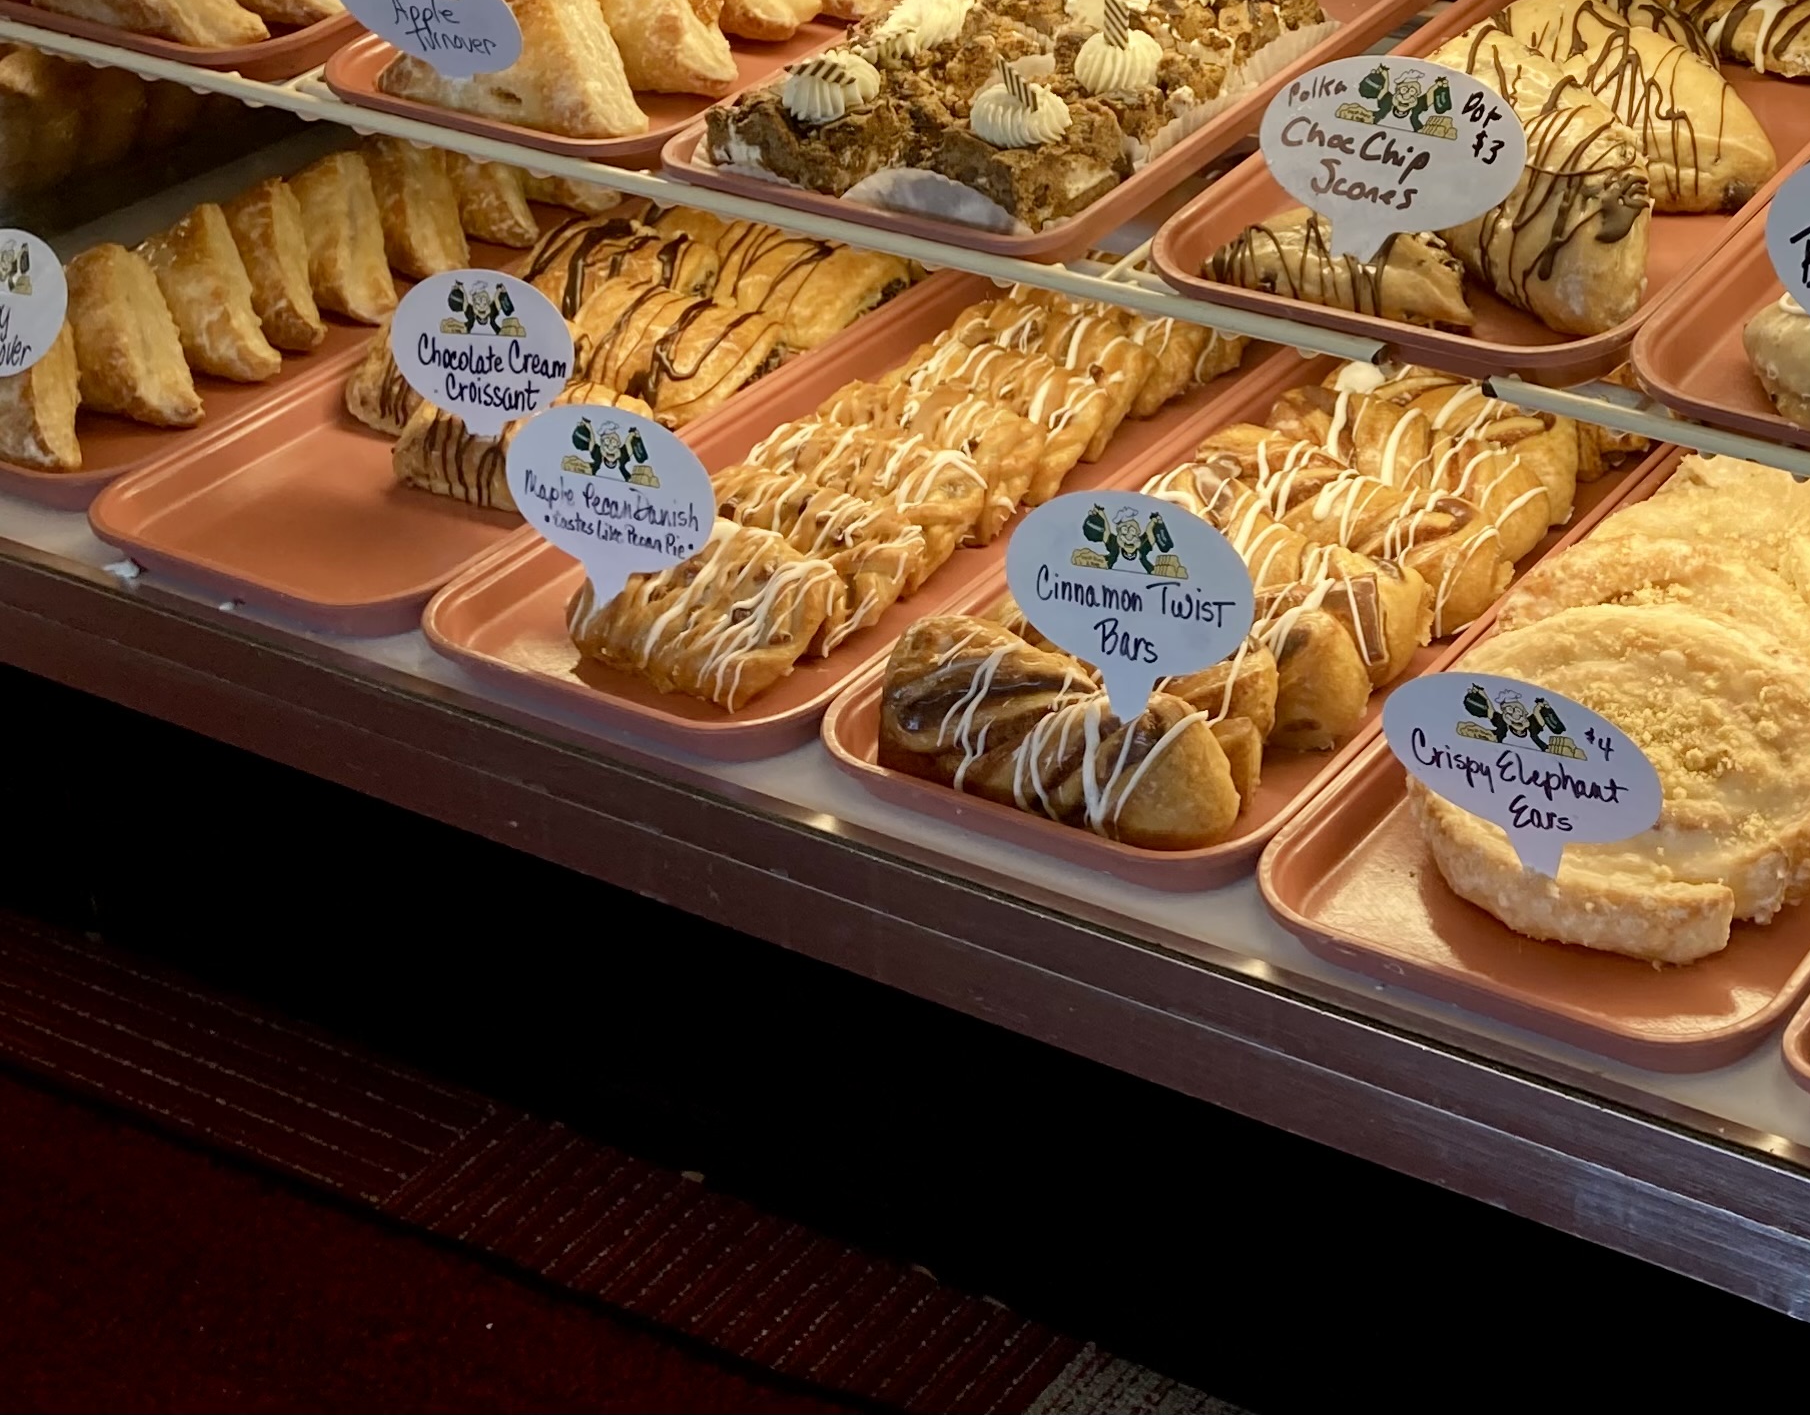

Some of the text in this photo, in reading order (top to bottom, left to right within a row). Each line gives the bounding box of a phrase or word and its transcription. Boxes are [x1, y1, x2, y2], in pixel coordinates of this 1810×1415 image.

[405, 25, 497, 56] Turnover
[1288, 76, 1347, 106] Polka
[1359, 131, 1430, 184] Chip
[1472, 130, 1505, 164] $3
[1310, 158, 1418, 210] Scones
[418, 333, 567, 379] Chocolate Cream
[445, 373, 540, 411] Croissant
[525, 469, 699, 531] Maple Pecan Danish
[626, 523, 662, 553] Pecan
[665, 532, 686, 559] Pie
[1036, 564, 1142, 612] Cinnamon
[1094, 618, 1158, 664] Bars
[1585, 727, 1614, 761] $4
[1411, 728, 1629, 803] Crispy Elephant
[1509, 794, 1573, 831] Ears
